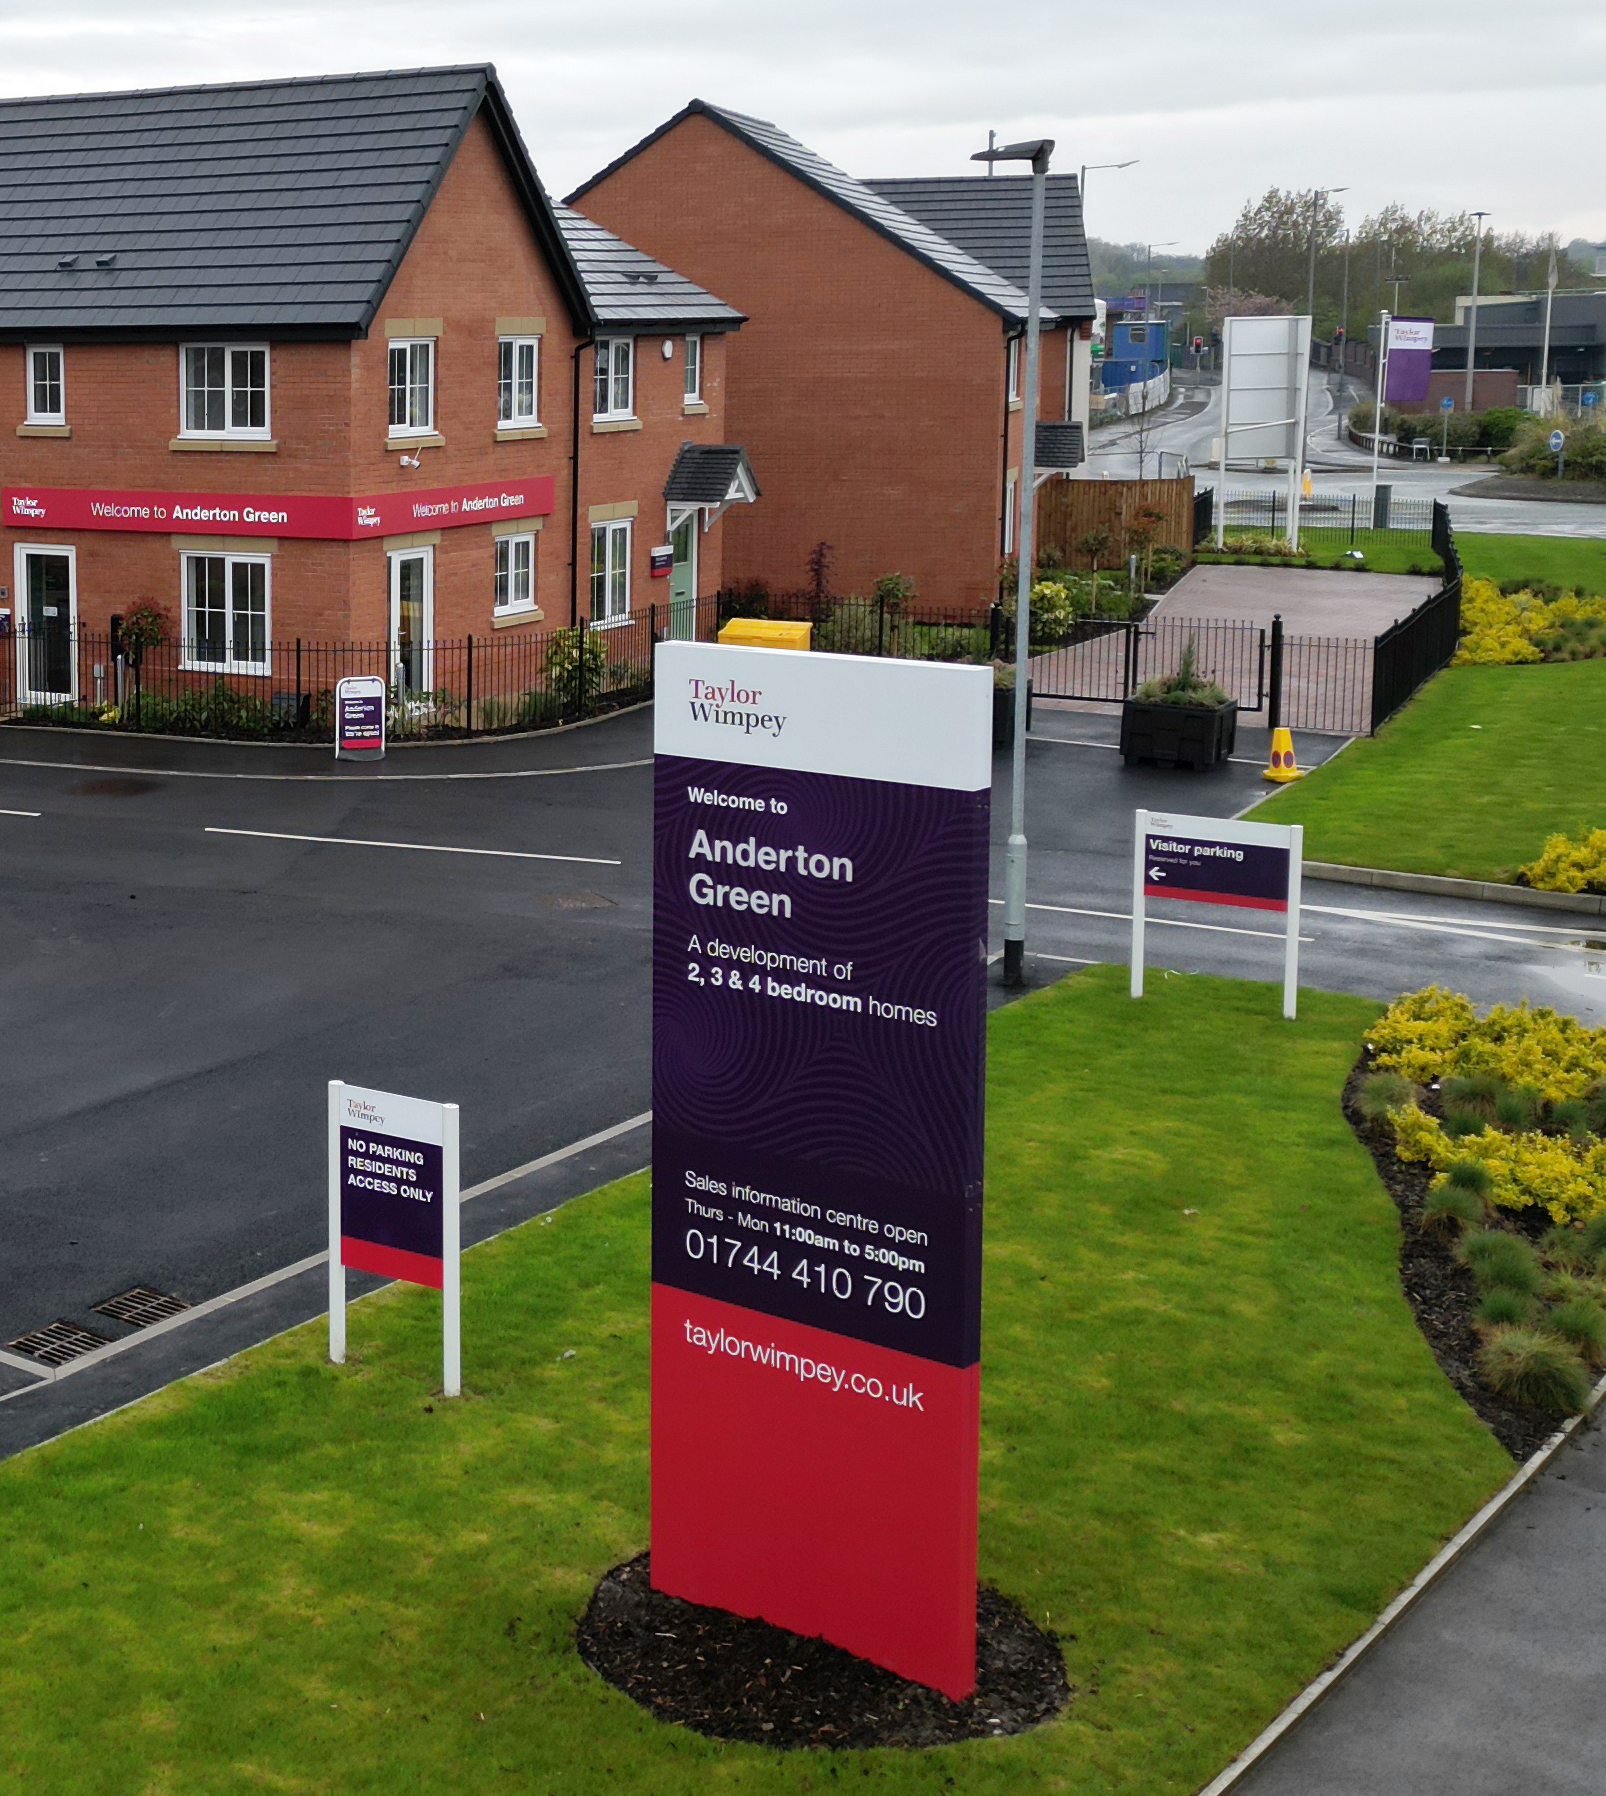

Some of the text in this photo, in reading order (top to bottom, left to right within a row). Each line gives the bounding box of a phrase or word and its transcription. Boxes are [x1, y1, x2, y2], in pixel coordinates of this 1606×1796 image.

[12, 496, 38, 507] Taylor
[12, 505, 46, 518] Wimpey
[91, 502, 288, 523] Welcome to Anderton Green
[413, 493, 524, 518] Welcome to Anderton Green
[688, 678, 762, 708] Taylor
[688, 702, 787, 738] Wimpey
[688, 786, 788, 815] Welcome to
[688, 829, 853, 882] Anderton
[1149, 839, 1244, 862] Visitor parking
[689, 872, 792, 918] Green
[687, 934, 854, 981] A development of
[687, 963, 937, 1027] 2, 3 & 4 bedroom homes
[347, 1098, 377, 1113] Taylor
[347, 1108, 386, 1125] Wimpey
[348, 1138, 424, 1166] NO PARKING
[348, 1156, 417, 1182] RESIDENTS
[348, 1174, 434, 1203] ACCESS ONLY
[685, 1170, 928, 1247] Sales information centre open
[684, 1197, 724, 1221] Thurs
[737, 1211, 769, 1233] Mon
[774, 1221, 839, 1252] 11:00am
[843, 1239, 860, 1257] to
[864, 1244, 925, 1274] 5:00pm
[686, 1229, 925, 1319] 01744 410 790
[684, 1318, 924, 1411] taylorwimpey.co.uk
